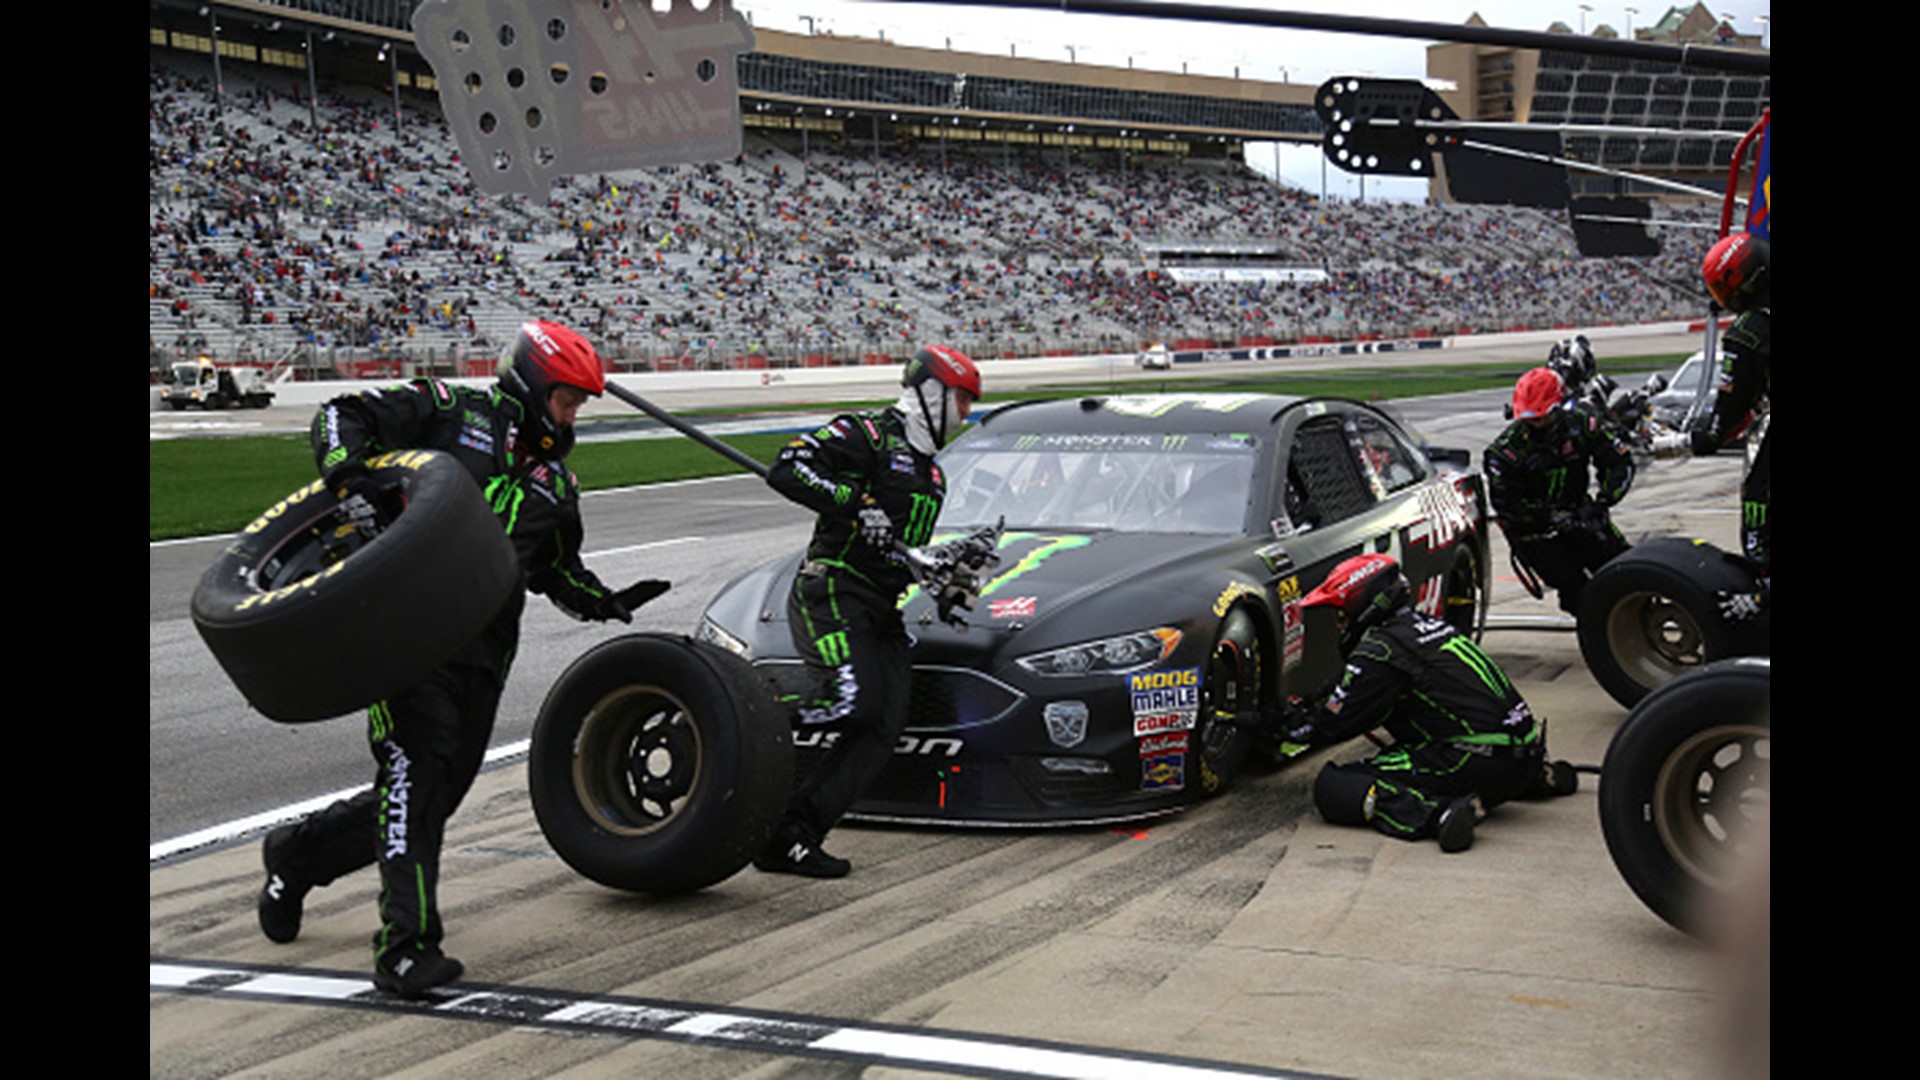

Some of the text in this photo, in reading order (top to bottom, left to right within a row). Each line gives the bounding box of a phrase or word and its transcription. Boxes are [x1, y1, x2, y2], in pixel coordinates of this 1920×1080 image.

[1132, 669, 1199, 691] MOOG
[1133, 688, 1198, 711] MAHLE
[384, 740, 412, 860] MONSTER
